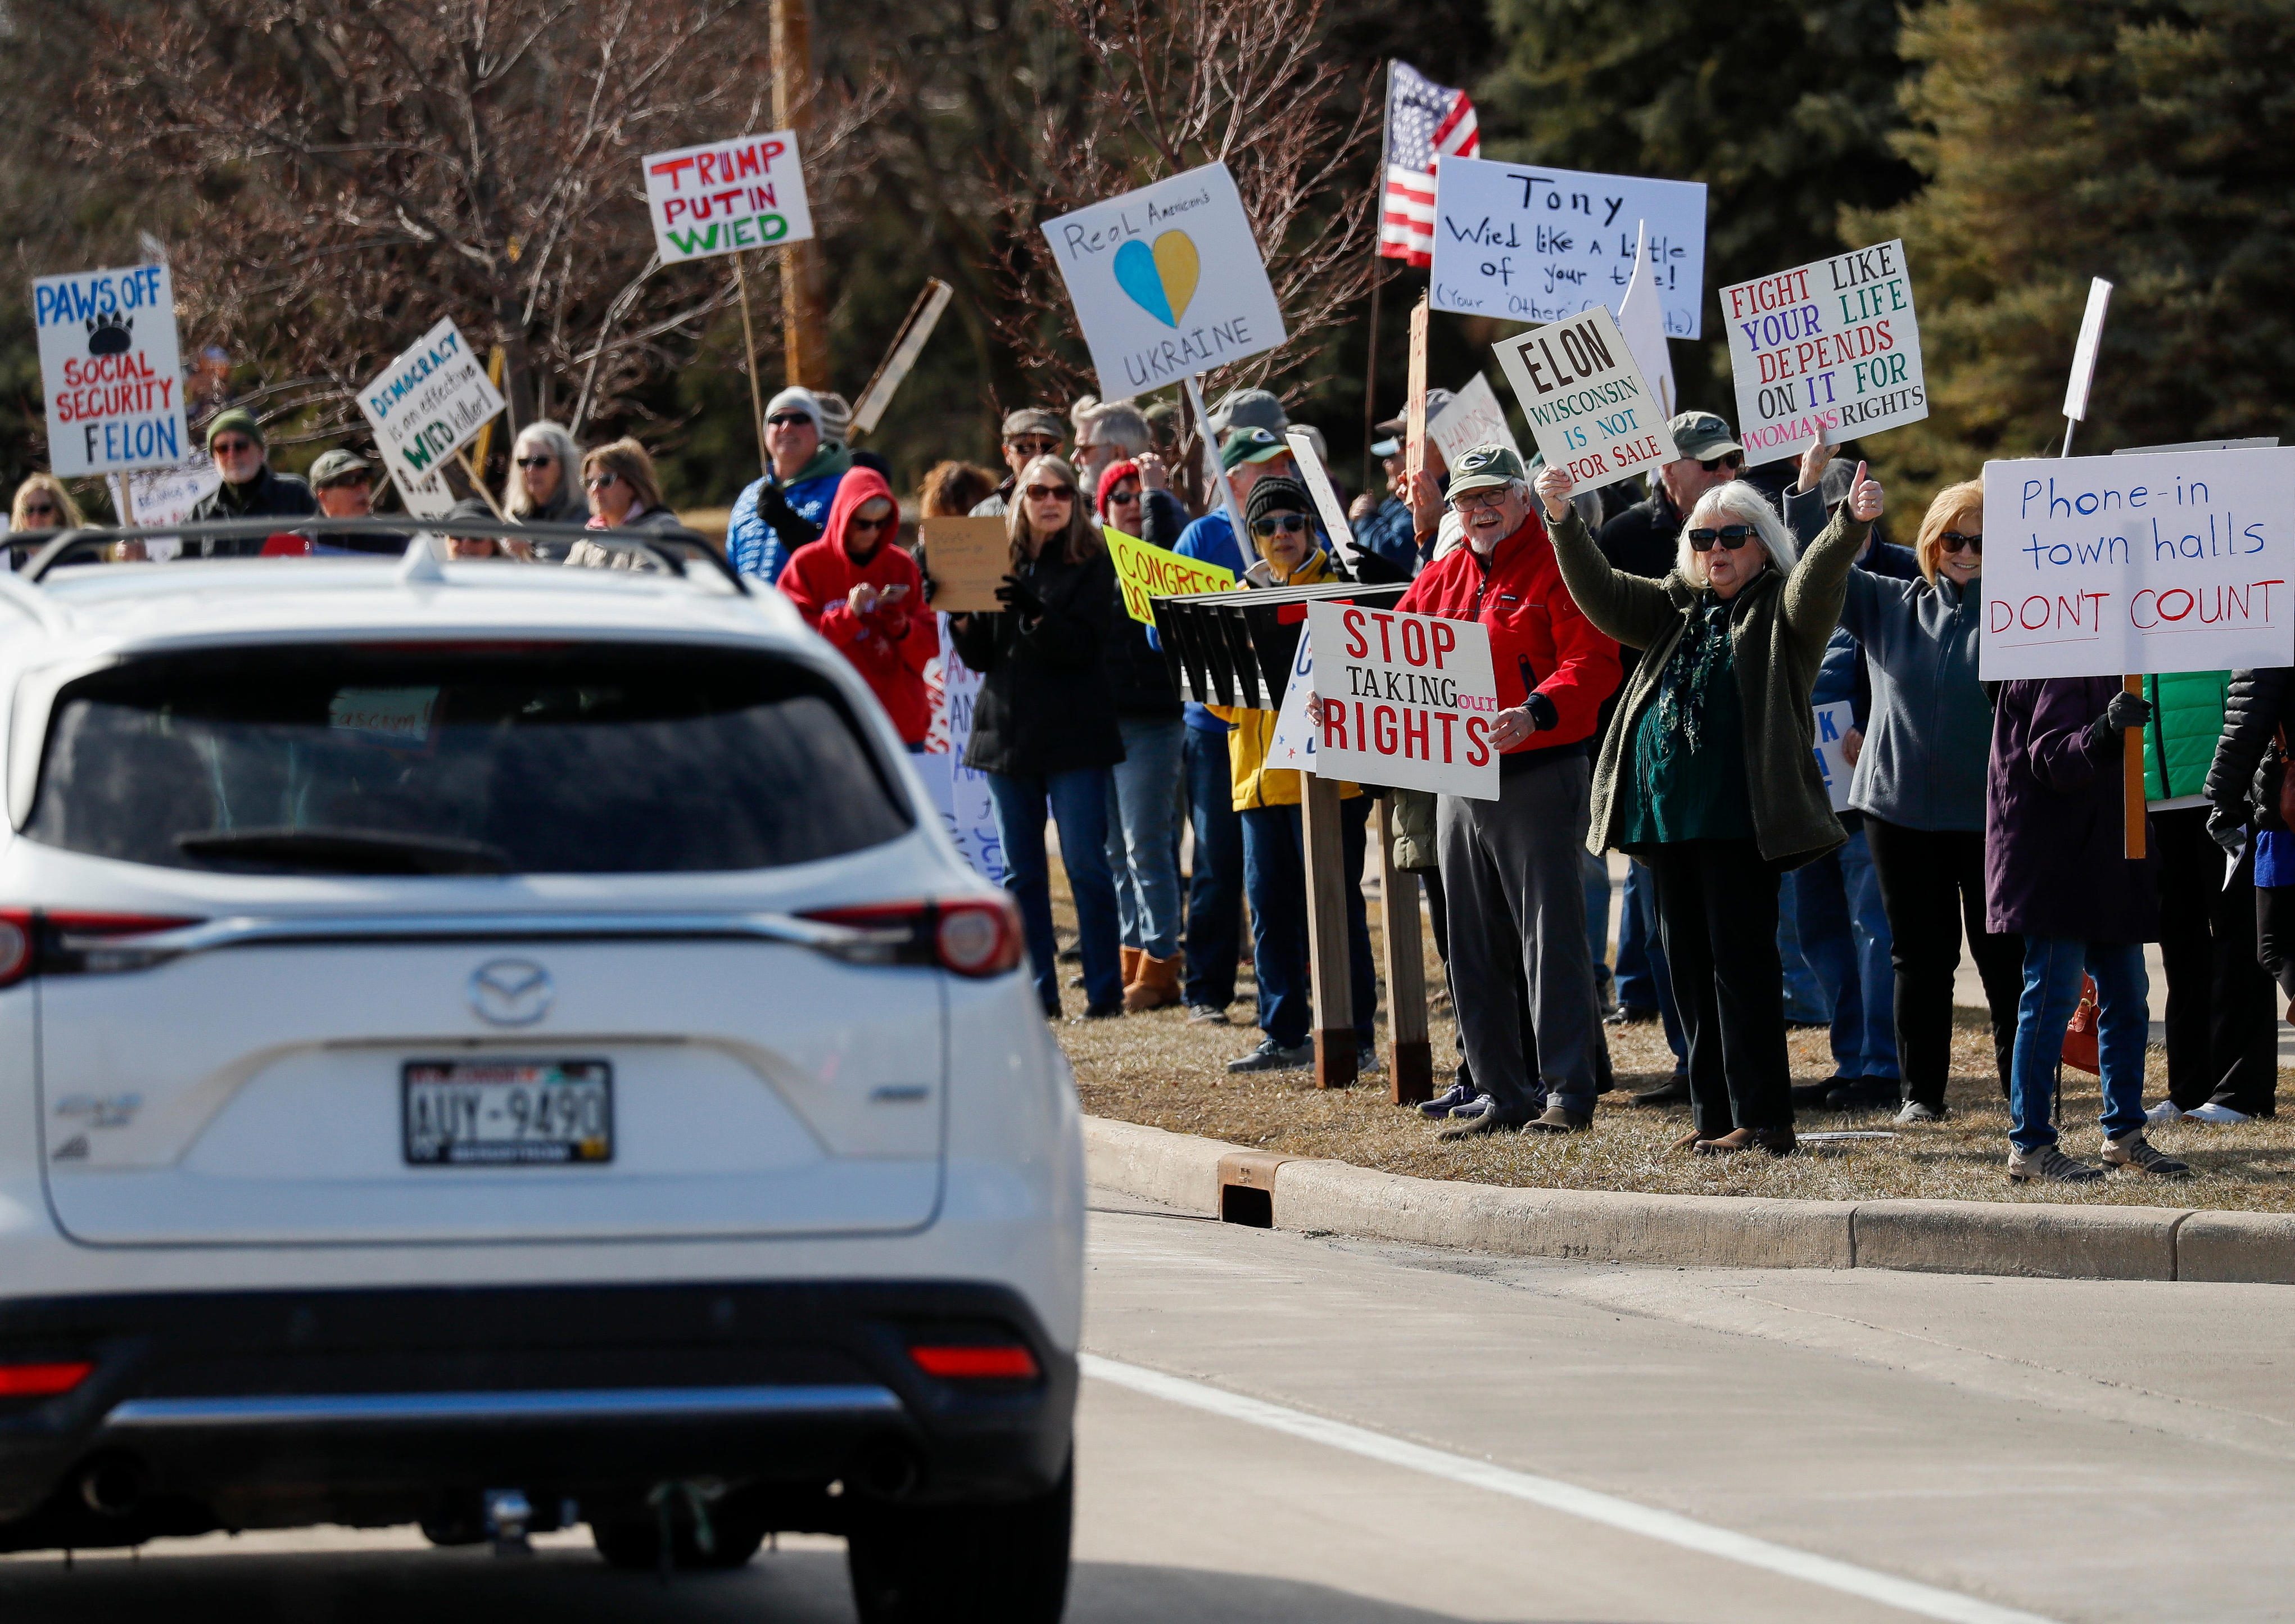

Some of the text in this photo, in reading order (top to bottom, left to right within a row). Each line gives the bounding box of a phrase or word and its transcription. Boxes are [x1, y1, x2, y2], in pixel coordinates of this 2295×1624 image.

[651, 141, 785, 190] TRUMP
[664, 183, 776, 224] PUTIN
[1506, 173, 1623, 227] Tony
[666, 214, 787, 254] WIED
[1445, 215, 1522, 248] Wied
[1620, 233, 1686, 264] Litle
[36, 265, 161, 327] PAWS OFF
[1480, 256, 1675, 294] of your te!
[1728, 268, 1810, 319] FIGHT
[1828, 245, 1896, 291] LIKE
[1740, 304, 1822, 352] YOUR
[1839, 278, 1907, 325] LIFE
[64, 350, 155, 387] SOCIAL
[370, 332, 459, 418] DEMOCRACY
[1517, 319, 1616, 395] ELON
[1757, 319, 1894, 384] DEPENDS
[56, 377, 174, 423] SECURITY
[1529, 376, 1640, 427] WISCONSIN
[1758, 352, 1908, 419] ON IT FOR
[85, 417, 179, 464] FELON
[1563, 408, 1638, 450] IS NOT
[1742, 385, 1925, 453] WOMANS RIGHTS
[402, 421, 454, 472] WIED
[1567, 435, 1662, 483] FOR SALE
[2022, 476, 2208, 519] Phone-in
[2022, 512, 2265, 570] town halls
[1990, 588, 2110, 634] DON'T
[2130, 580, 2285, 629] COUNT
[1343, 609, 1456, 669] STOP
[1346, 666, 1497, 712] TAKING our
[1323, 698, 1490, 767] RIGHTS
